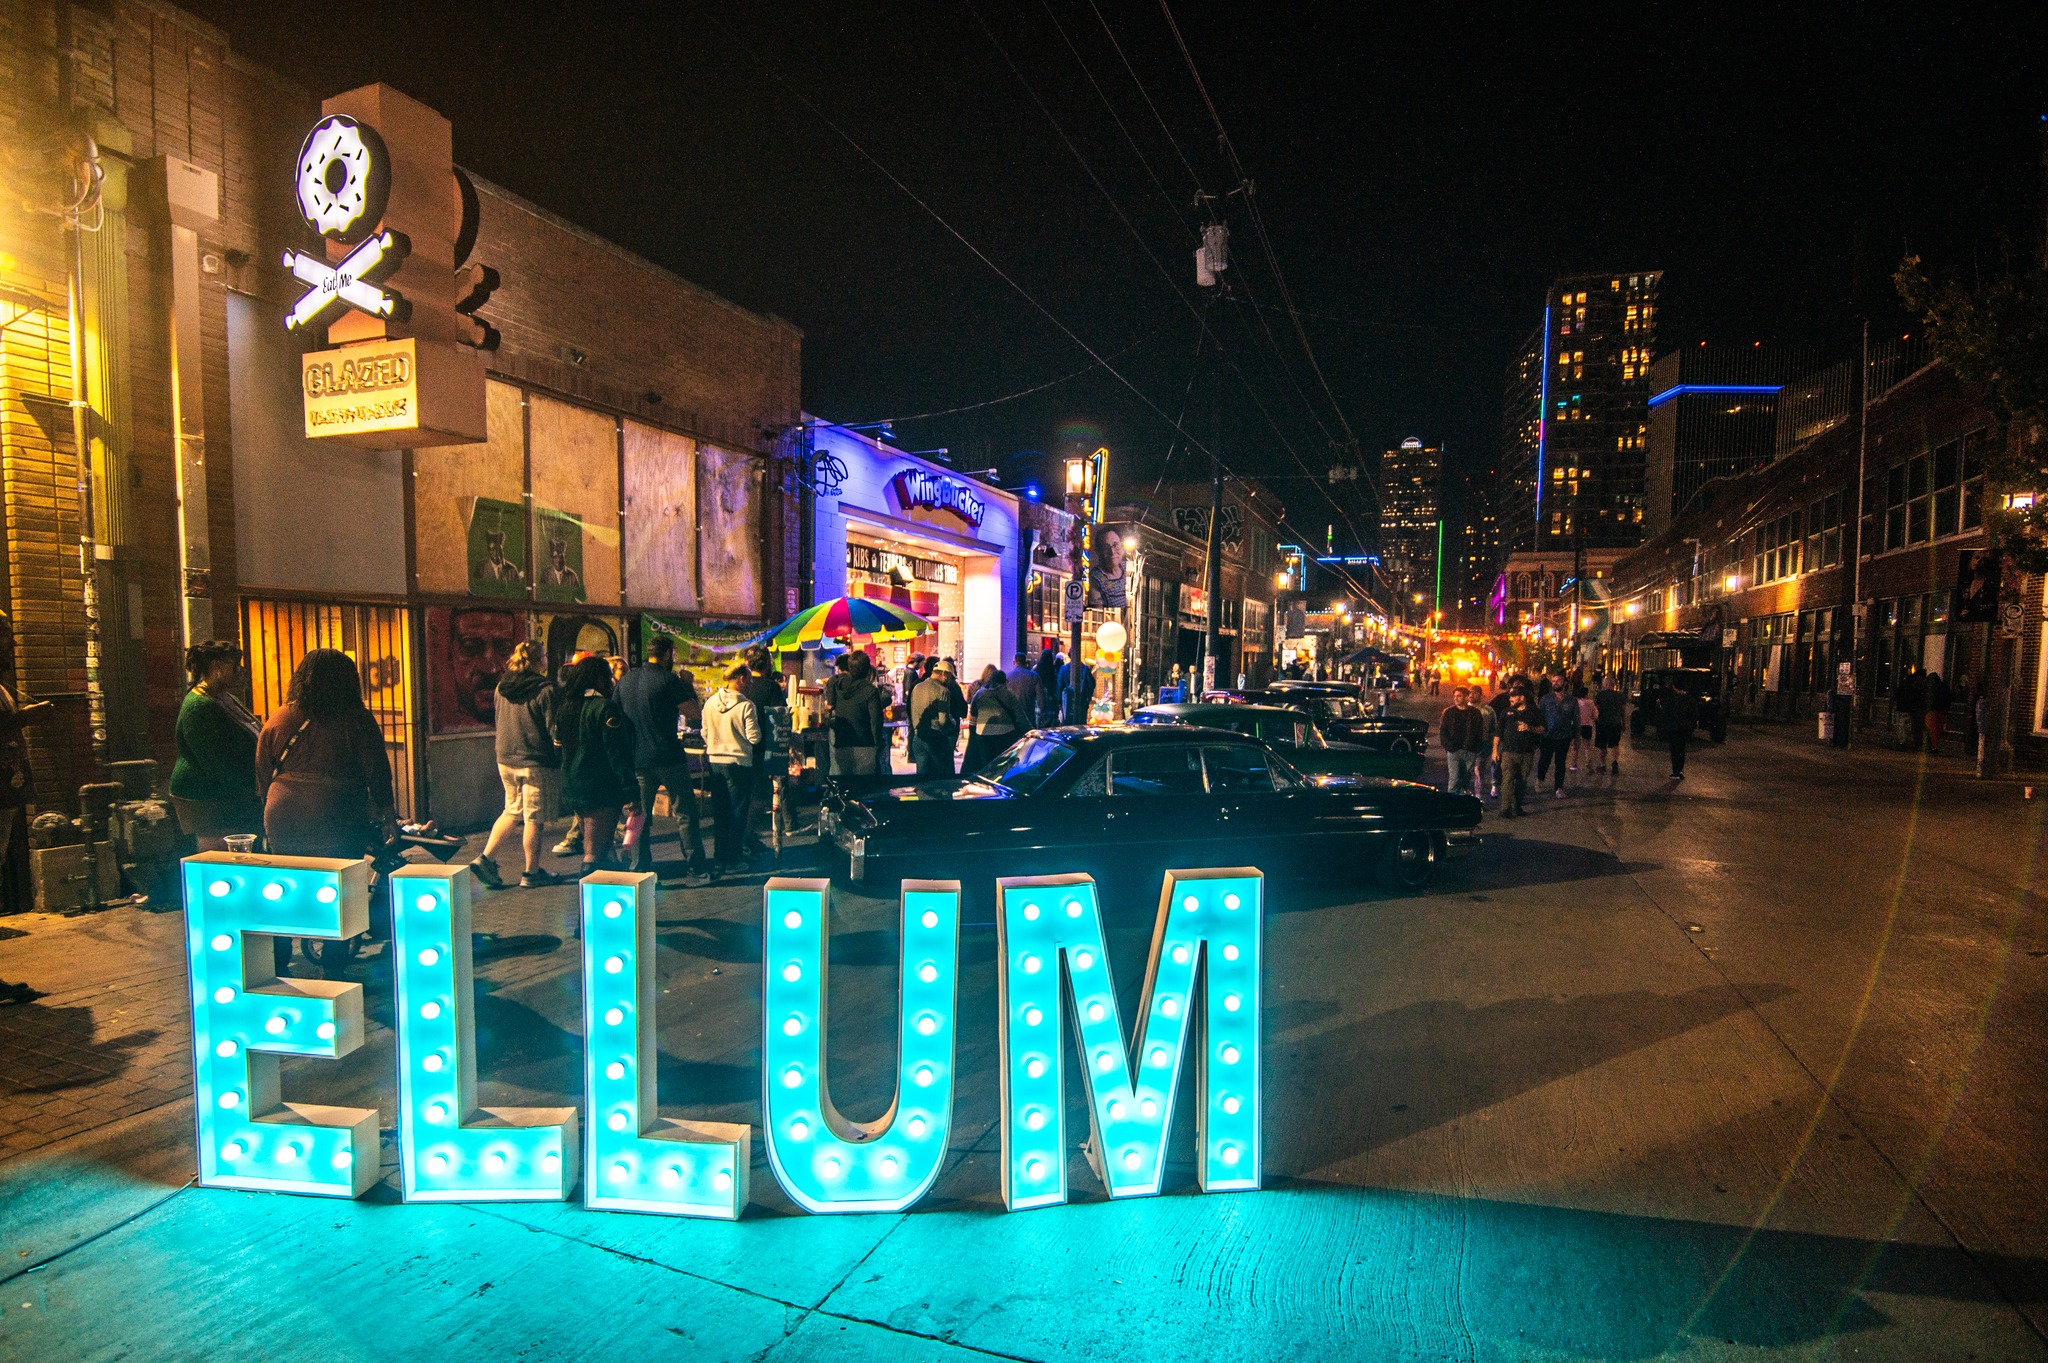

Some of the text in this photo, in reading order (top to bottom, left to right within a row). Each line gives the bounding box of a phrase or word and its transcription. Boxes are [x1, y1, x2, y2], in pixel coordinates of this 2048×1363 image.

[322, 272, 353, 294] Eat Me
[306, 352, 413, 398] GLAZED
[853, 546, 870, 569] RIBS
[181, 852, 1264, 1221] ELLUM
